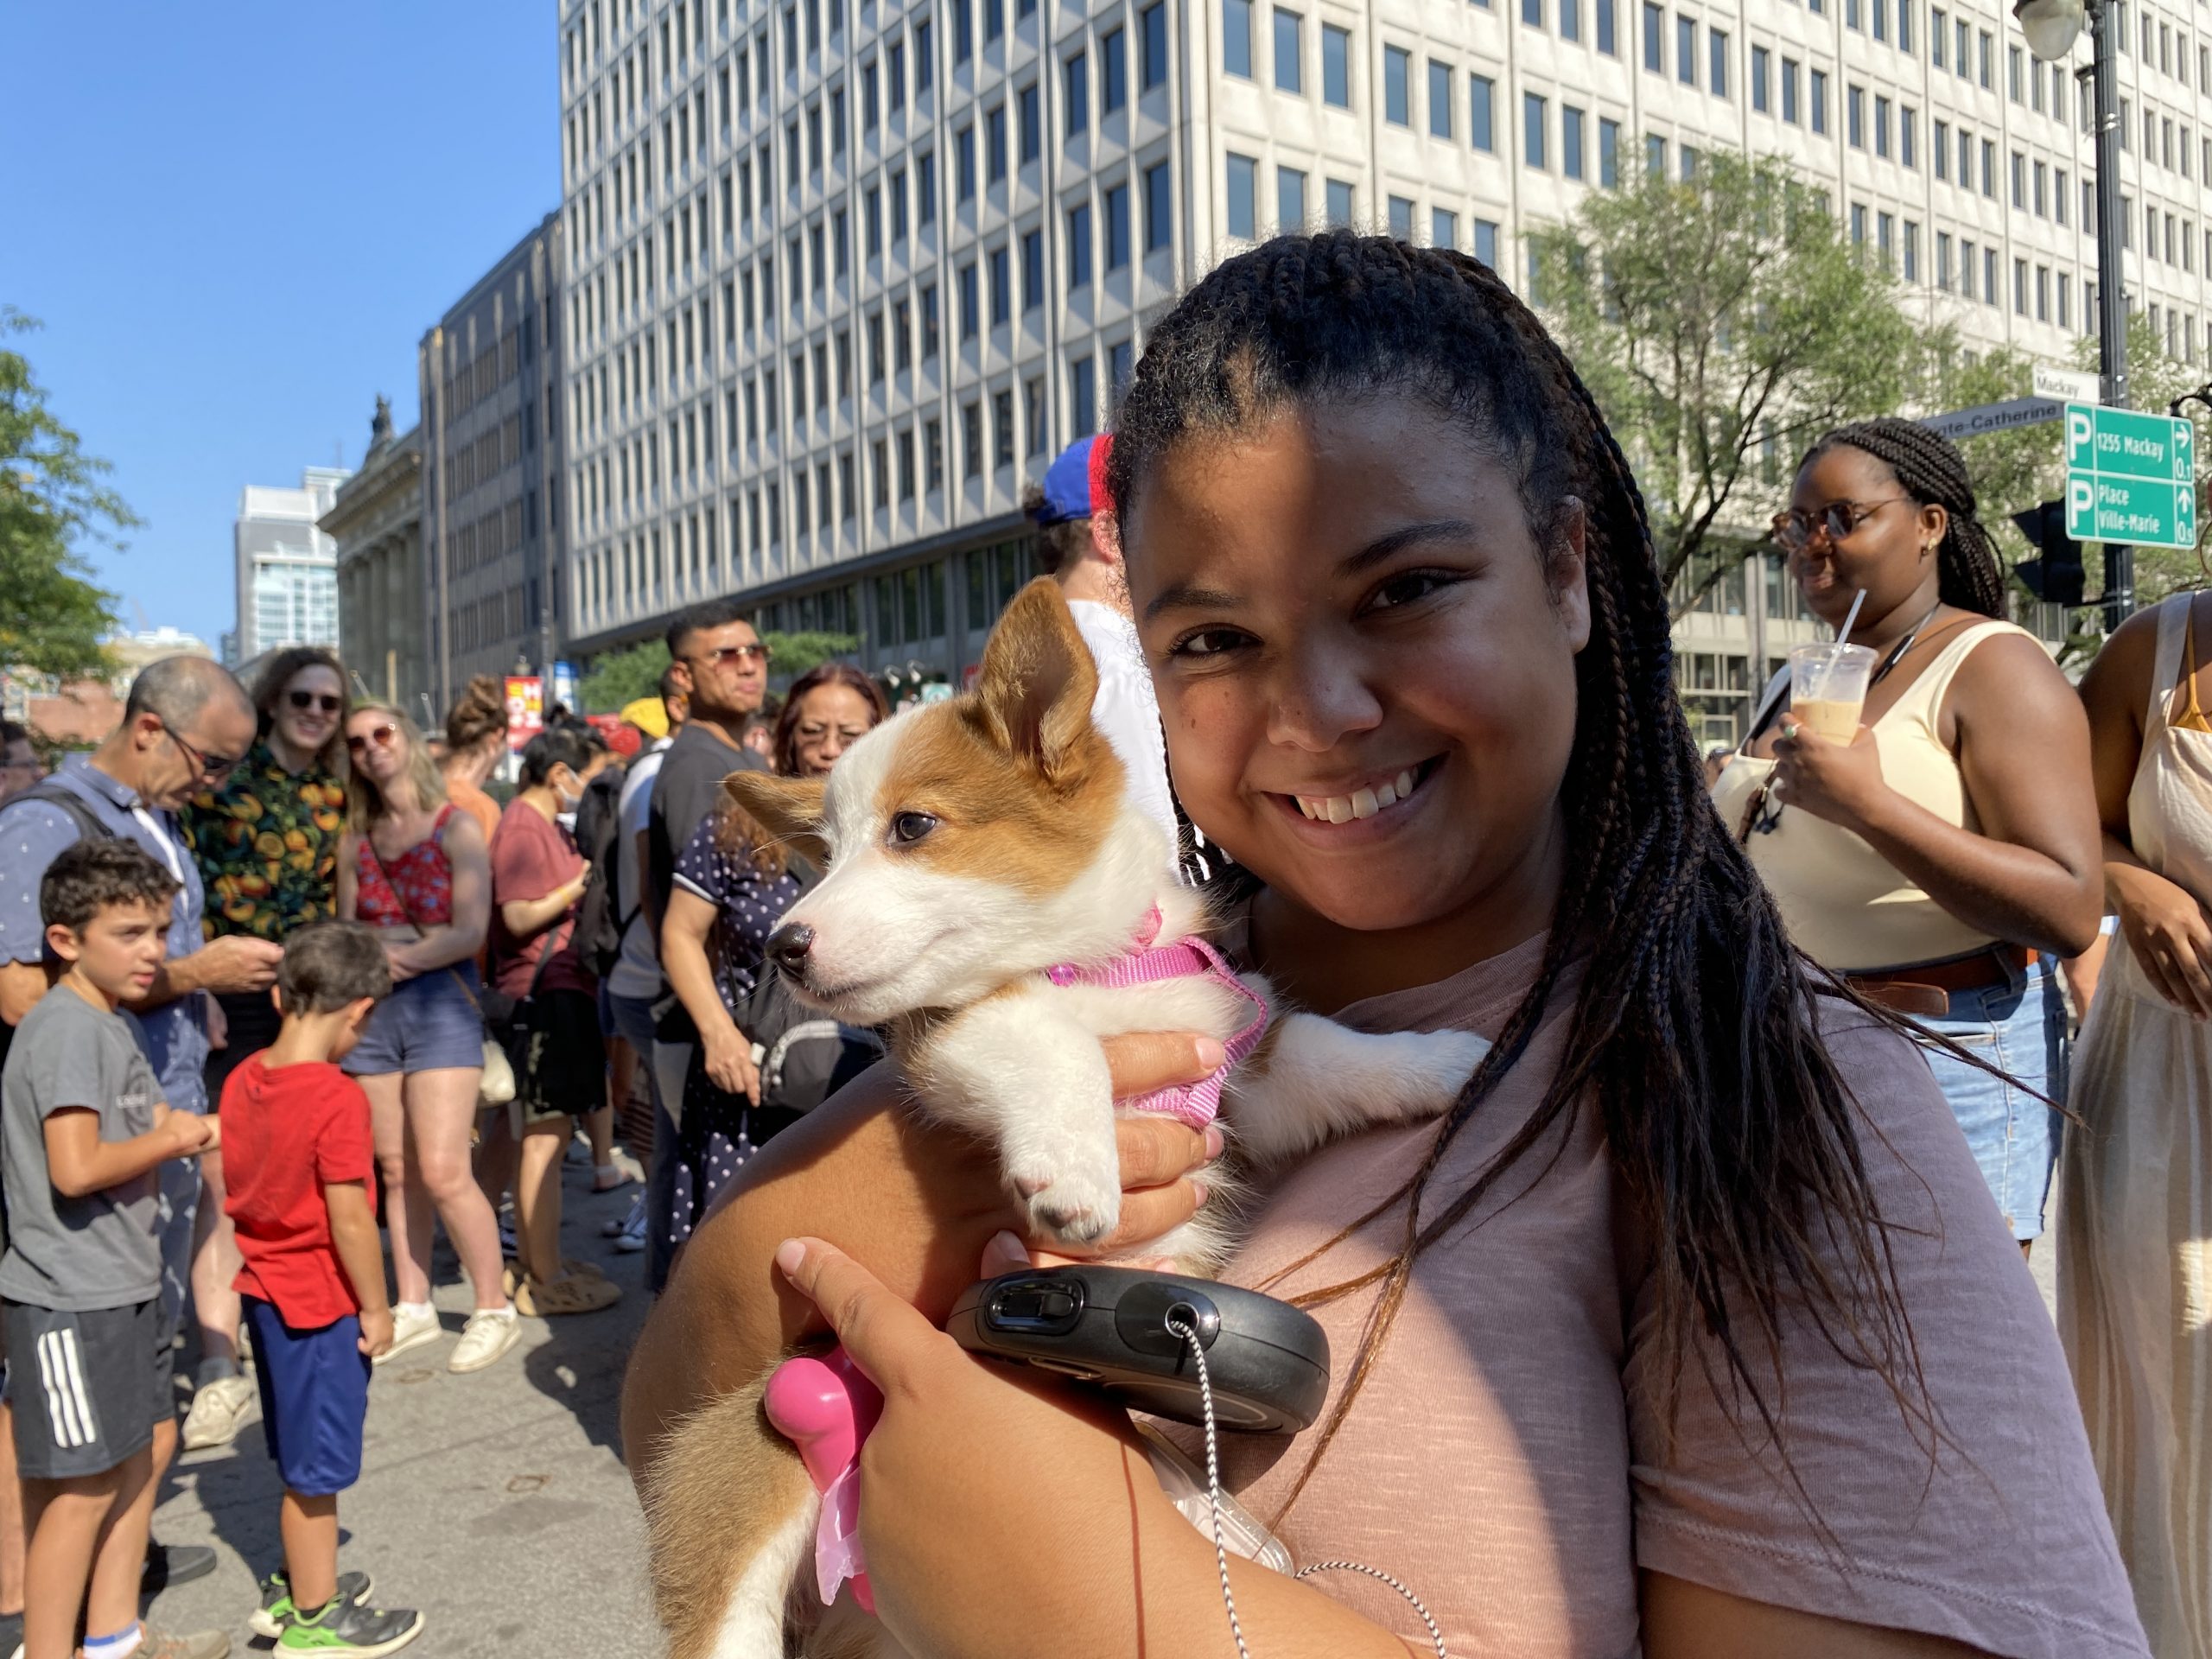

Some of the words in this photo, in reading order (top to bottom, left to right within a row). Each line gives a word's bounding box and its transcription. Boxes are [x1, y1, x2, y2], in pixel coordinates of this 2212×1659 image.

[2037, 375, 2080, 399] Mackay
[2069, 411, 2092, 461] P
[2097, 432, 2121, 454] 1255
[2124, 435, 2164, 463] Mackay
[2070, 480, 2094, 529] P
[2099, 484, 2129, 506] Place
[2100, 509, 2160, 534] Ville-Marie
